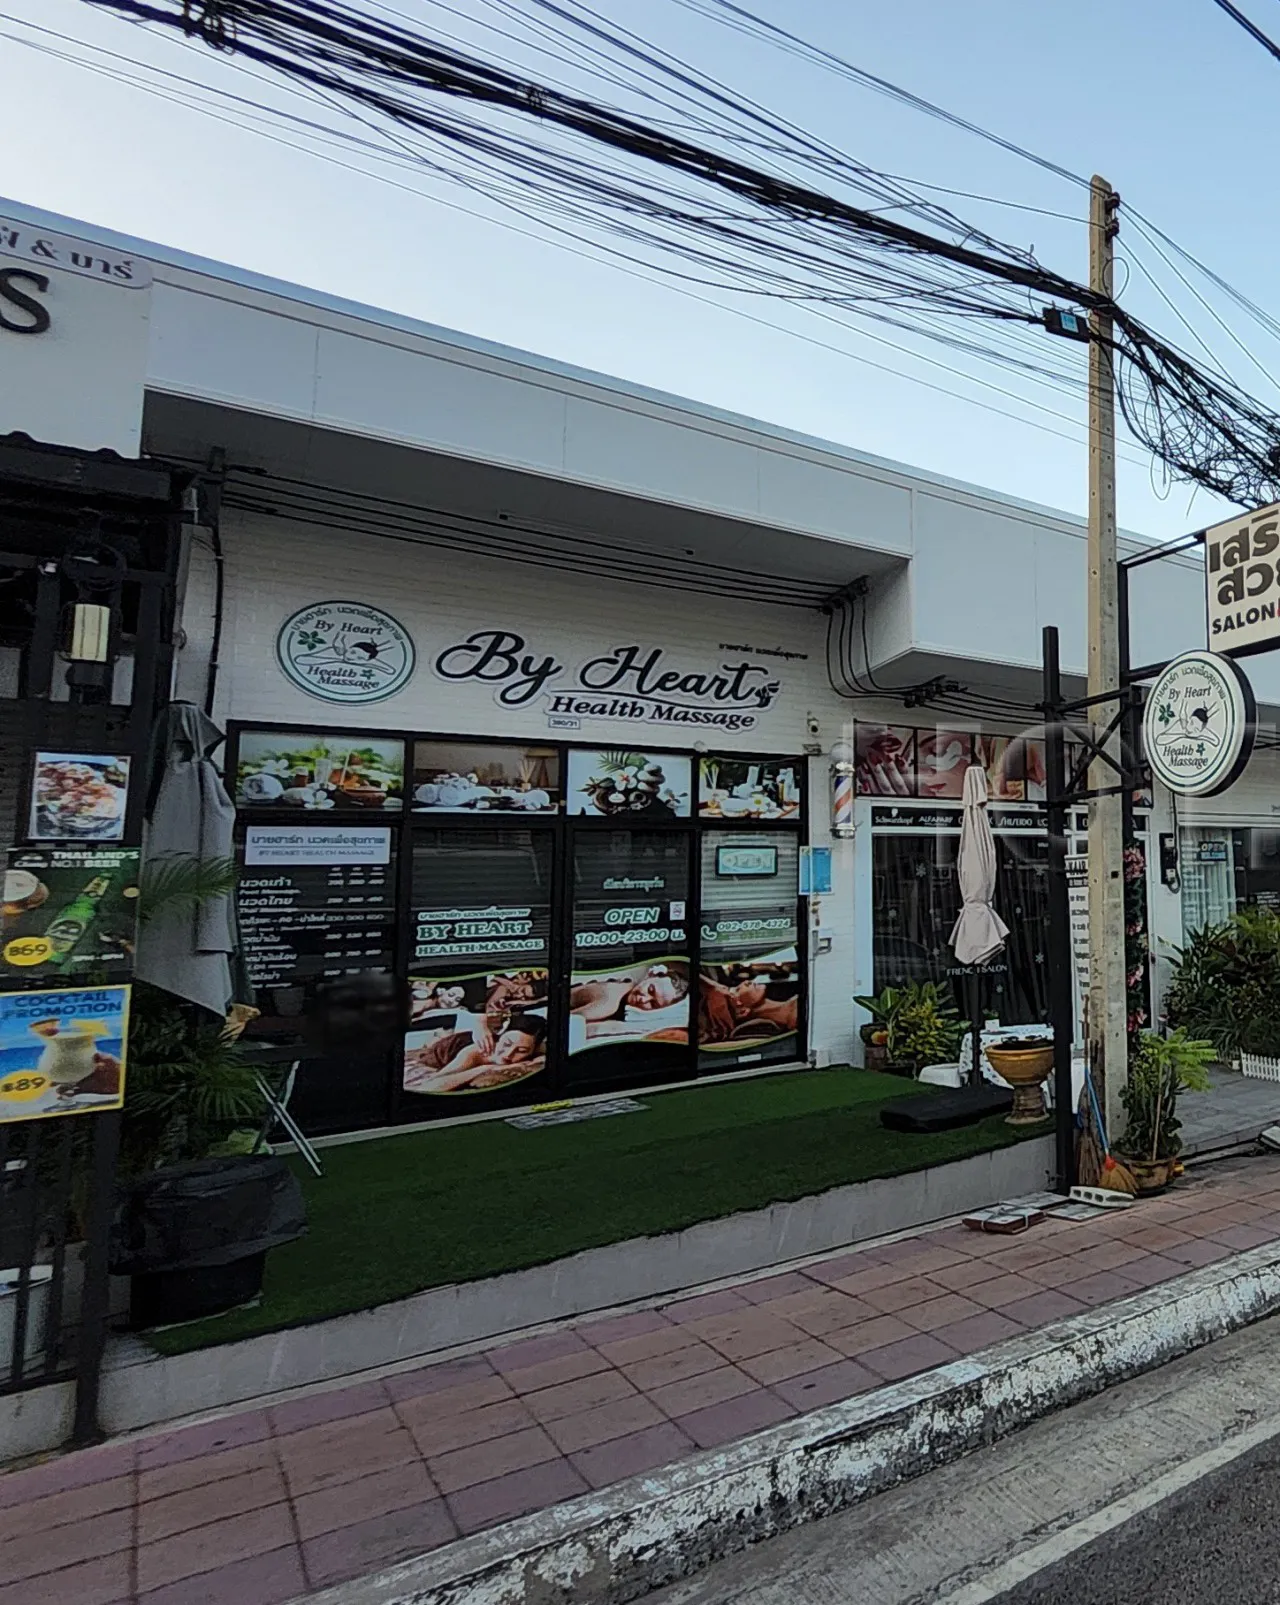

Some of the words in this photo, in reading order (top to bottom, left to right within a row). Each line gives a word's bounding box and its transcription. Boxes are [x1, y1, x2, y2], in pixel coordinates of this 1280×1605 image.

[31, 239, 60, 260] &
[71, 252, 134, 280] บาร์
[1212, 603, 1275, 634] SALON
[314, 620, 335, 632] By
[340, 622, 383, 635] Heart
[306, 665, 358, 678] Health
[435, 630, 563, 704] By
[579, 645, 769, 701] Heart
[316, 675, 380, 690] Massage
[1168, 688, 1181, 702] By
[1184, 685, 1212, 698] Heart
[550, 696, 646, 718] Health
[651, 704, 755, 731] Massage
[1162, 745, 1194, 757] Health
[1168, 755, 1209, 769] Massage
[605, 908, 660, 924] OPEN
[418, 926, 449, 939] BY
[456, 922, 531, 936] HEART
[576, 929, 668, 946] 10:00-23:00
[418, 943, 475, 955] HEALTH
[479, 940, 543, 952] MASSAGE
[14, 992, 110, 1008] COCKTAIL
